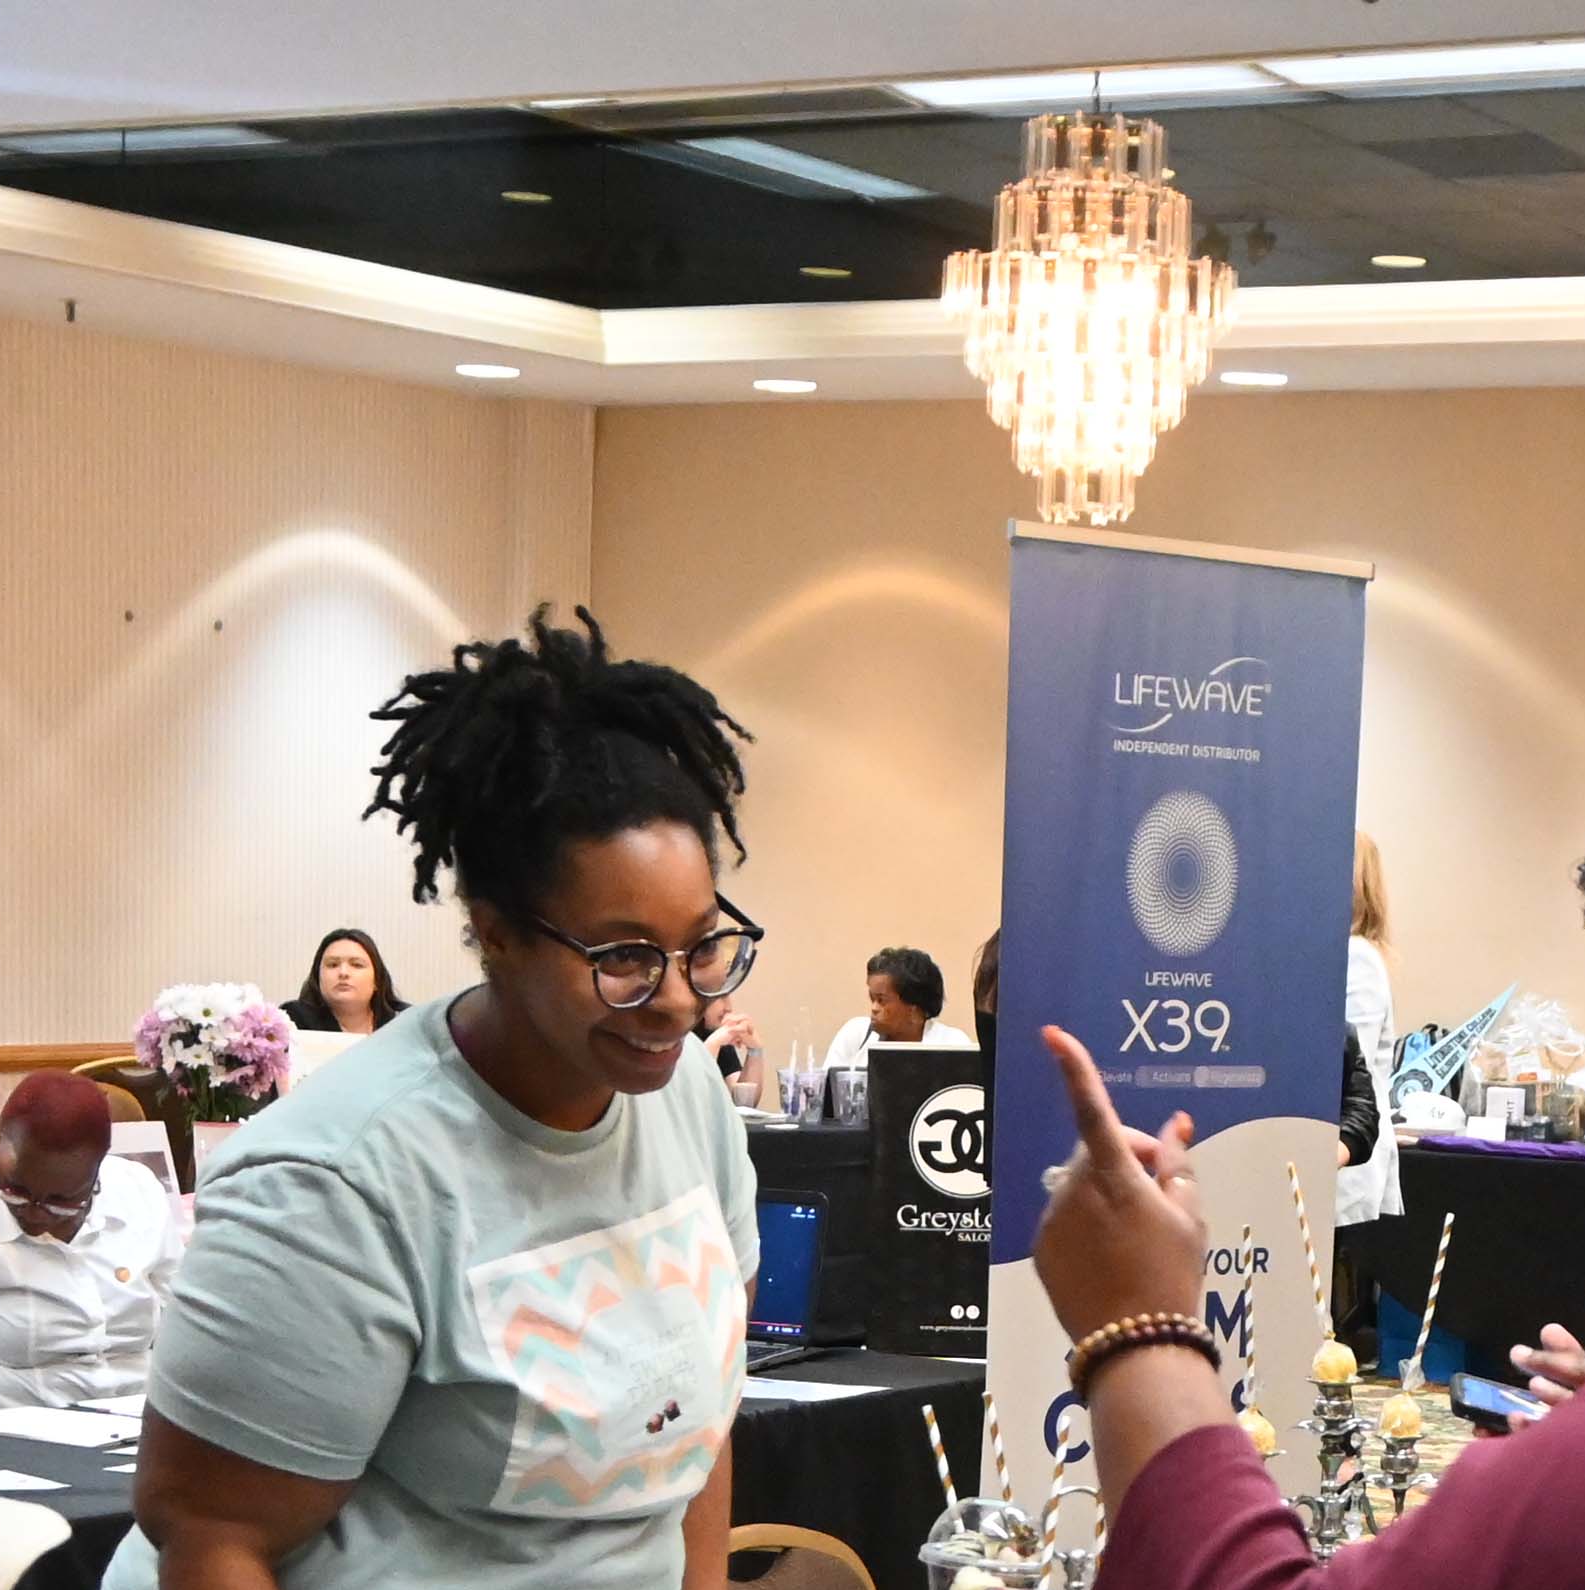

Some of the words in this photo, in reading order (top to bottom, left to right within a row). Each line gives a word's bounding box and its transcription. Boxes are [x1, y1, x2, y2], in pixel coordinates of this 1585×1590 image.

[1113, 738, 1190, 757] INDEPENDENT
[1192, 745, 1261, 762] DISTRIBUTOR
[1145, 971, 1214, 988] LIFEWAVE
